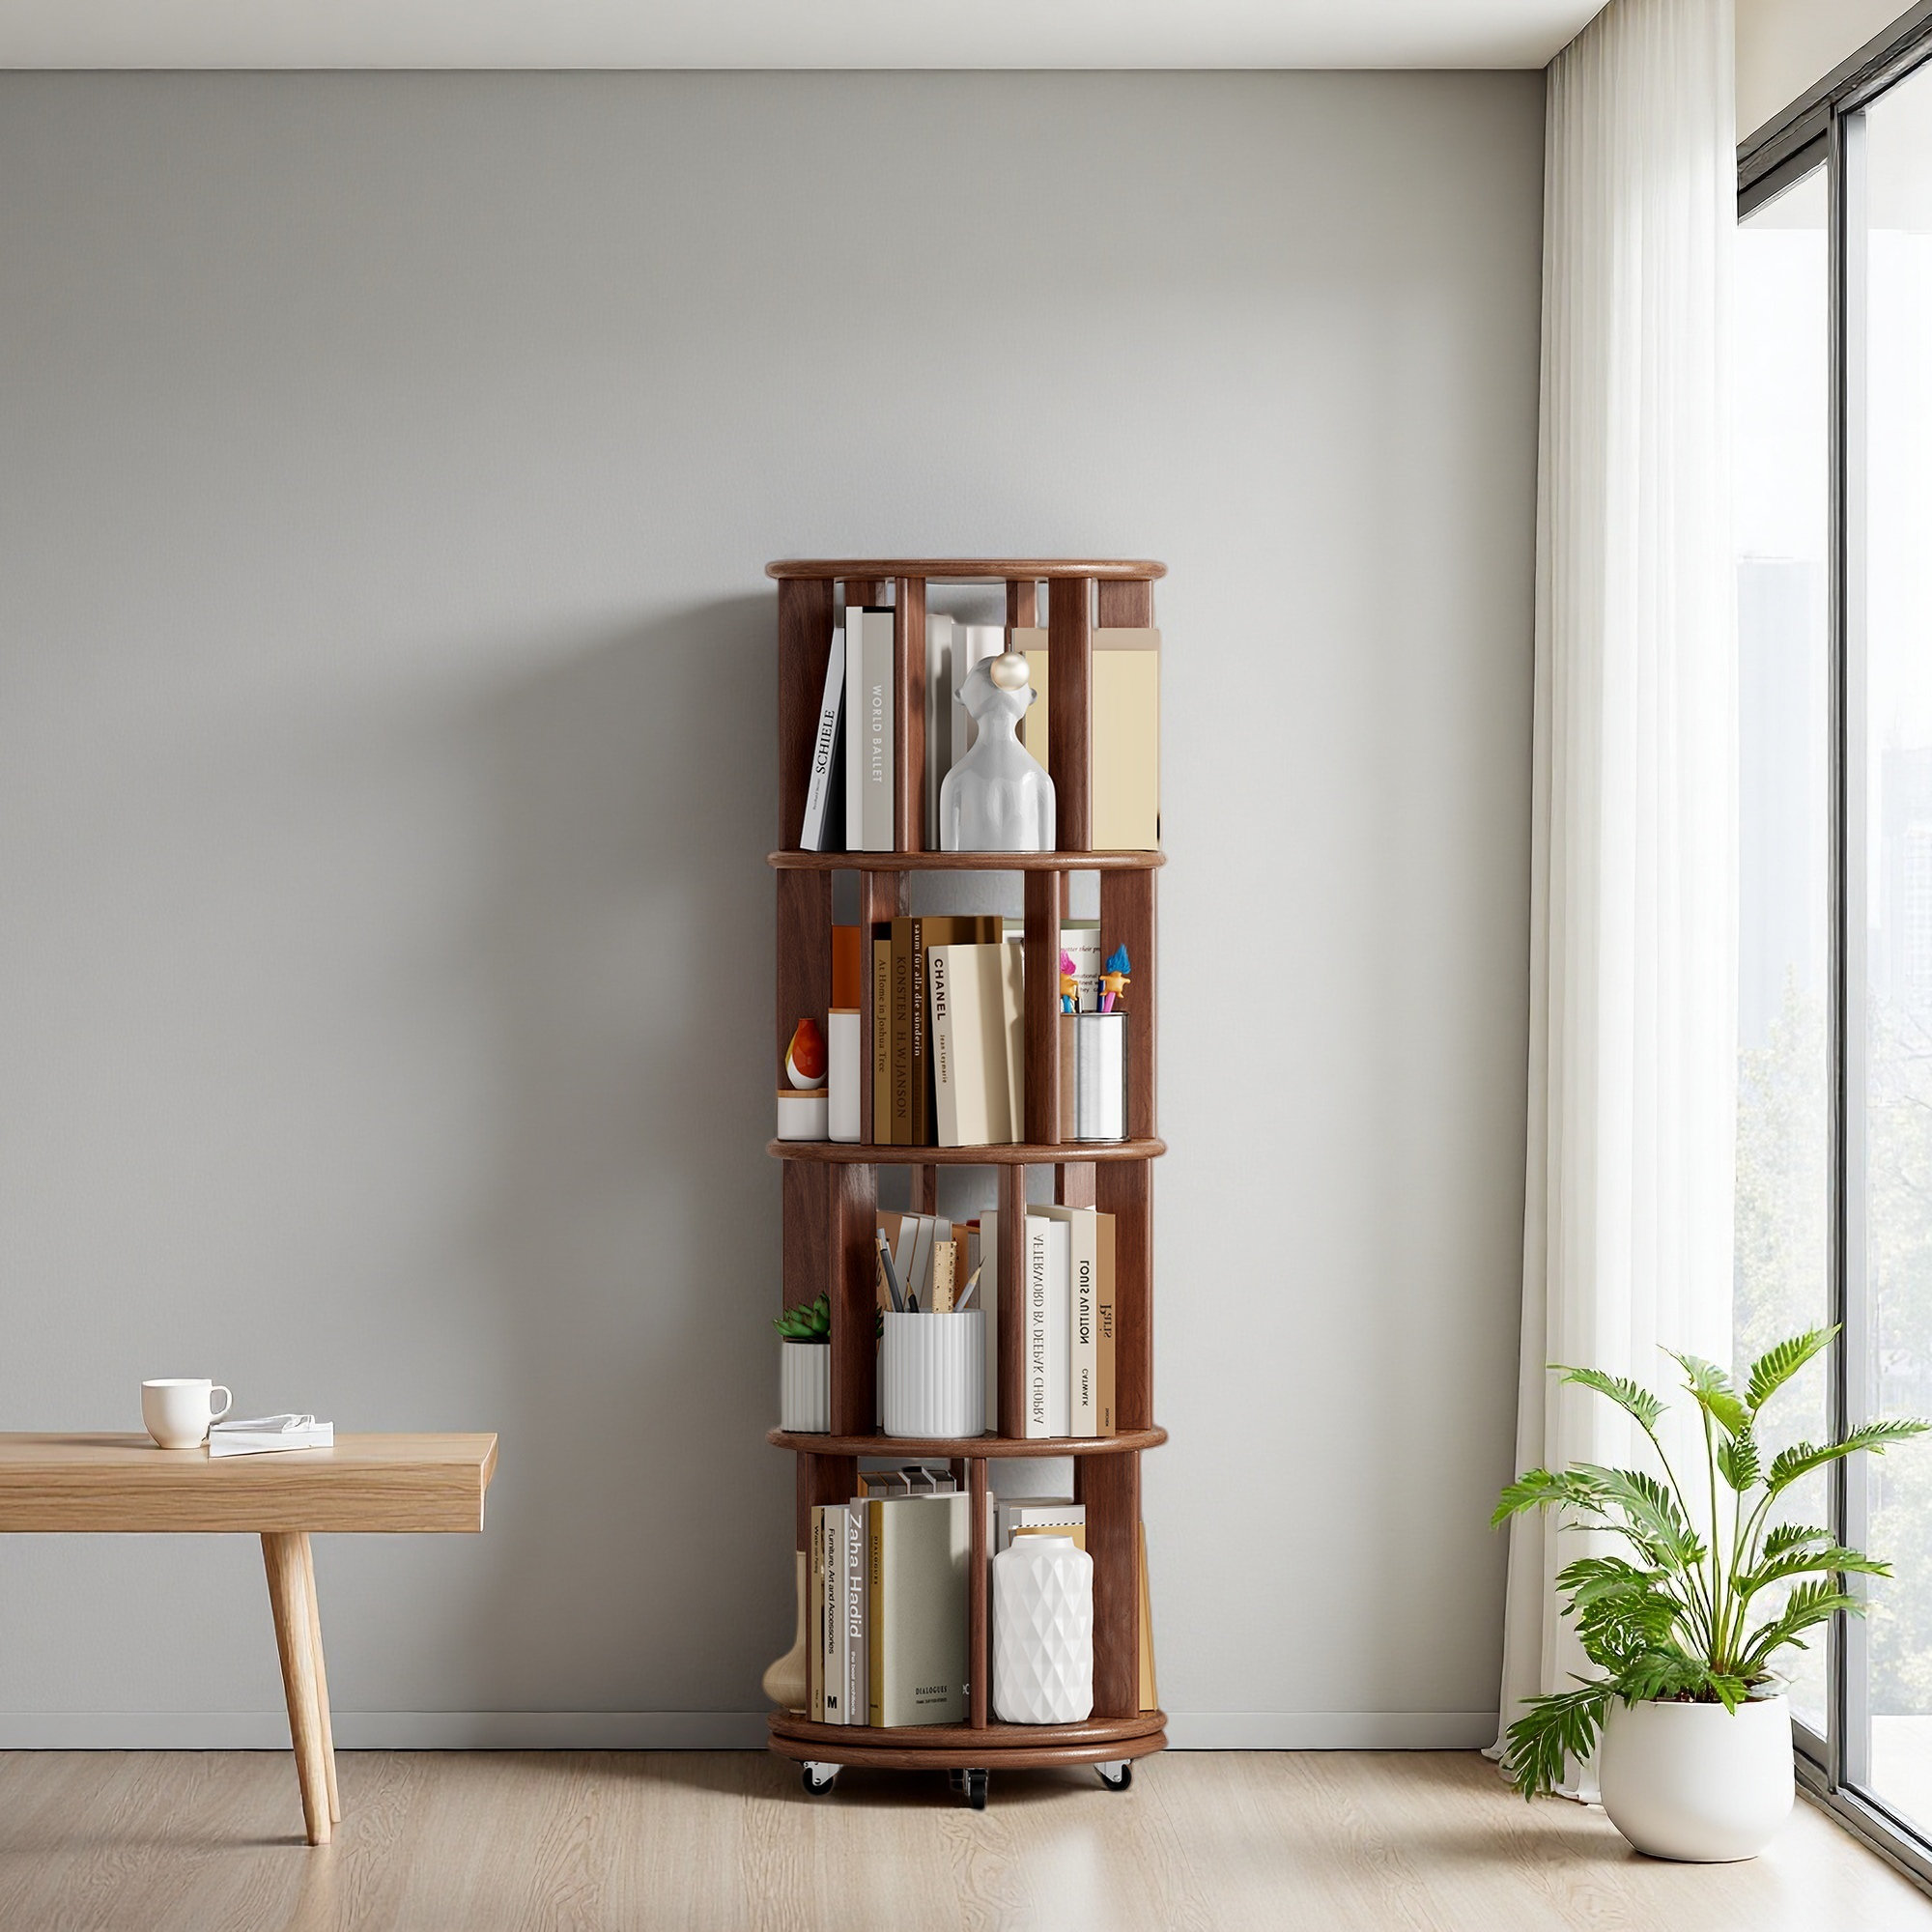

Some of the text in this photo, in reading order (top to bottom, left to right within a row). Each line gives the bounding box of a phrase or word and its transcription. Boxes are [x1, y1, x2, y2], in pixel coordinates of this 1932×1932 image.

[815, 709, 835, 775] SCHIELE
[871, 685, 883, 783] WORLD BALLET
[876, 959, 888, 1073] At Home in Joshua Tree
[895, 956, 907, 1021] KONSTEN
[914, 992, 923, 1009] die
[933, 958, 947, 1021] CHANEL
[849, 1514, 862, 1638] Zaha Hadid
[827, 1694, 838, 1710] M
[915, 1685, 948, 1695] DIALOGUES
